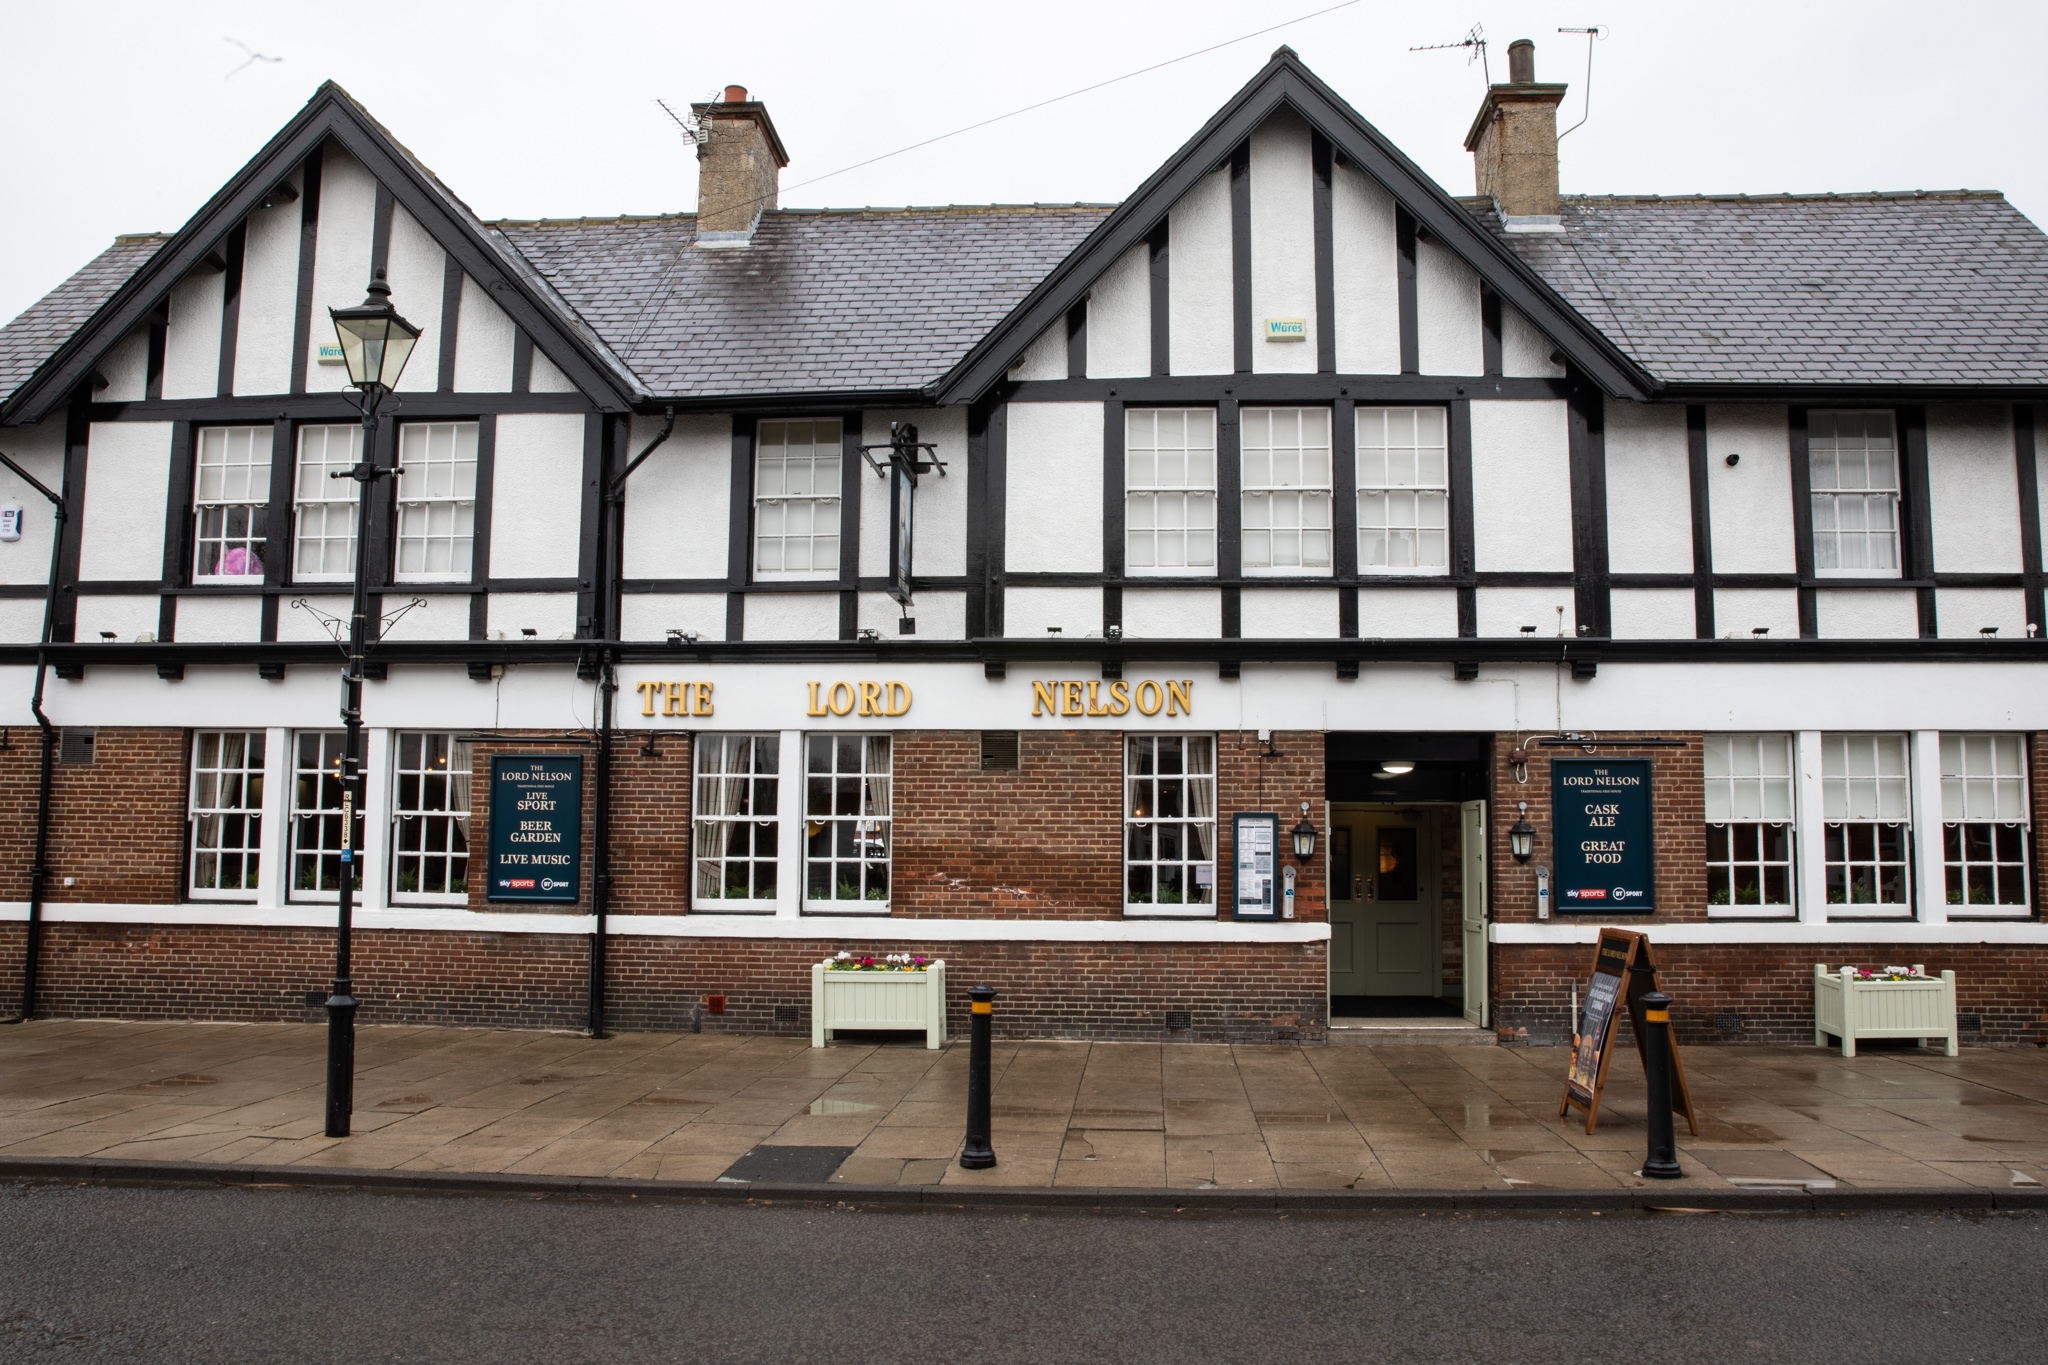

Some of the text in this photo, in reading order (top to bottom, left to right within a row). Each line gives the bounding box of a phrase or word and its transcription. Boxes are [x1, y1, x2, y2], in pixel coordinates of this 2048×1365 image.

[1271, 321, 1303, 333] Wares
[320, 346, 343, 356] Ware
[637, 680, 1194, 717] THE LORD NELSON
[501, 772, 572, 781] LORD NELSON
[1563, 777, 1640, 786] LORD NELSON
[526, 792, 548, 800] LIVE
[517, 800, 557, 811] SPORT
[1585, 804, 1620, 815] CASK
[520, 821, 553, 831] BEER
[1589, 816, 1616, 827] ALE
[510, 832, 562, 843] GARDEN
[1581, 841, 1625, 851] GREAT
[500, 854, 571, 865] LIVE MUSIC
[1585, 853, 1622, 864] FOOD
[499, 880, 534, 889] sky sports
[1567, 889, 1605, 898] sky sports
